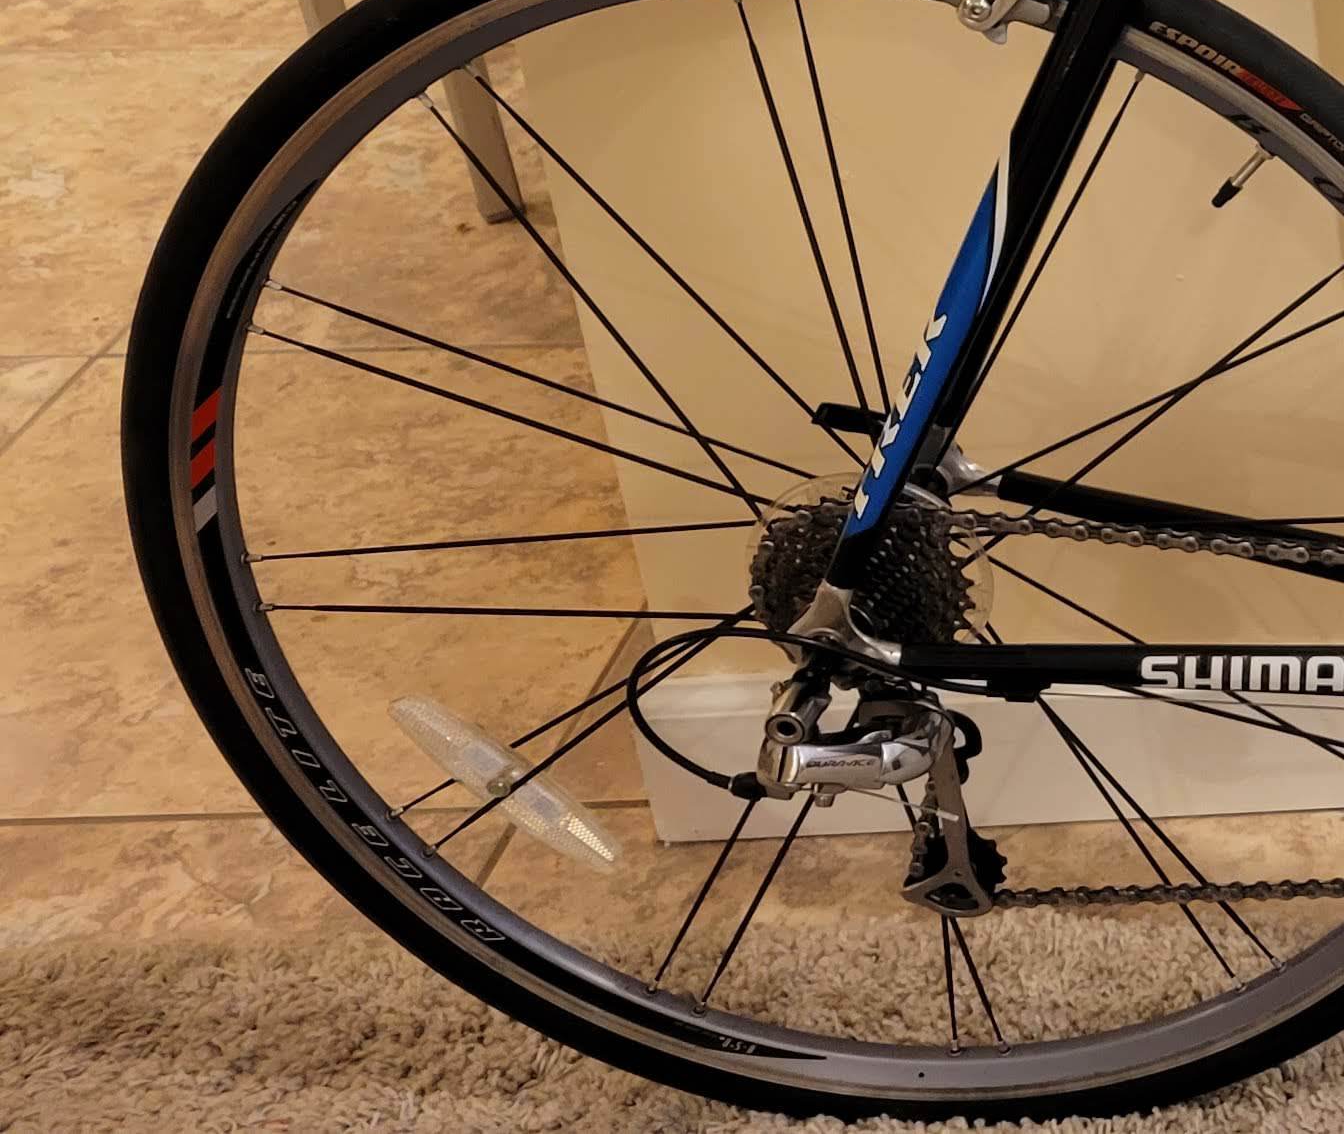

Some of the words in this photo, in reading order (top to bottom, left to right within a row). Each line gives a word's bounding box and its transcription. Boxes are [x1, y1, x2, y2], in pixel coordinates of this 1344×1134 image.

[1150, 21, 1244, 73] ESPOIR
[244, 667, 348, 803] LITE
[352, 823, 505, 941] RACE
